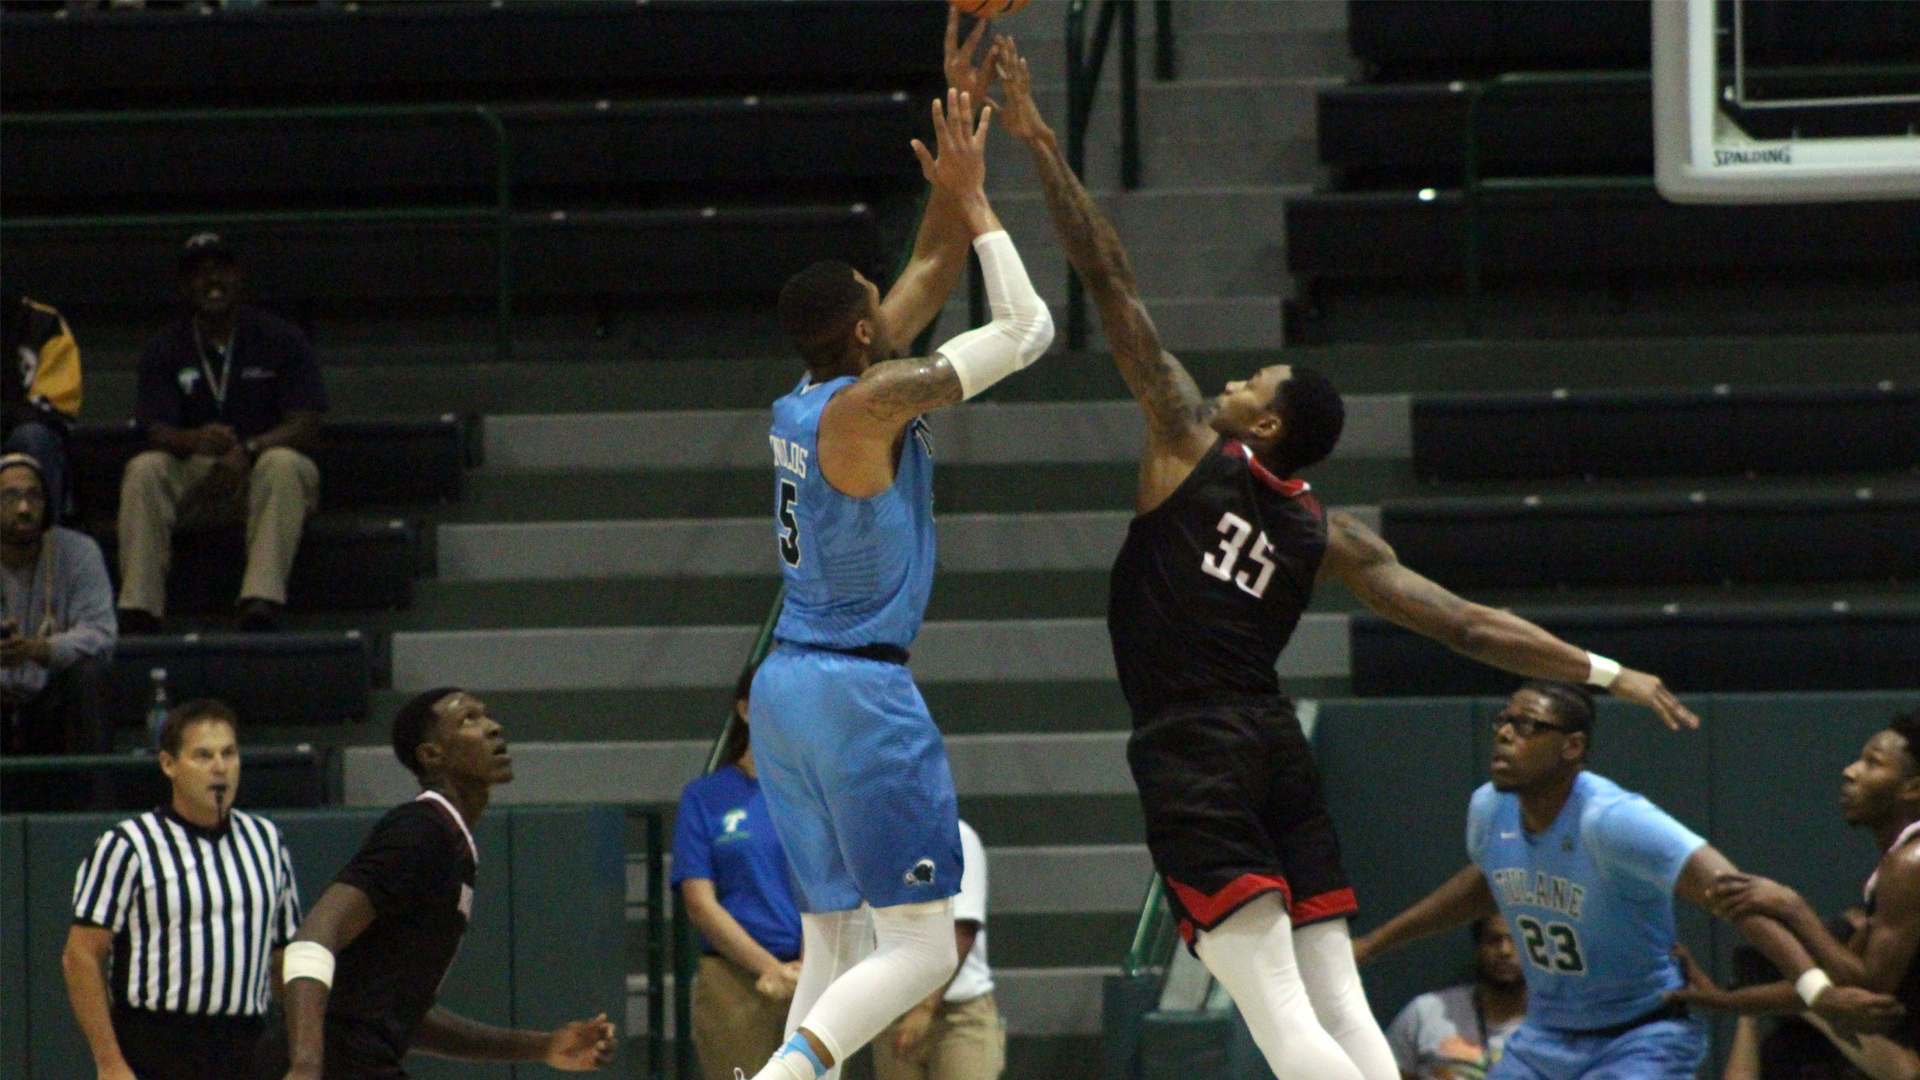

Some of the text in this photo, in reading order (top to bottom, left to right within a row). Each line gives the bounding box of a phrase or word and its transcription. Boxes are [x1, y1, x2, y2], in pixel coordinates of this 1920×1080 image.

[778, 477, 801, 569] 5
[1200, 511, 1276, 600] 35
[1493, 866, 1586, 924] TULANE
[1516, 914, 1588, 978] 23
